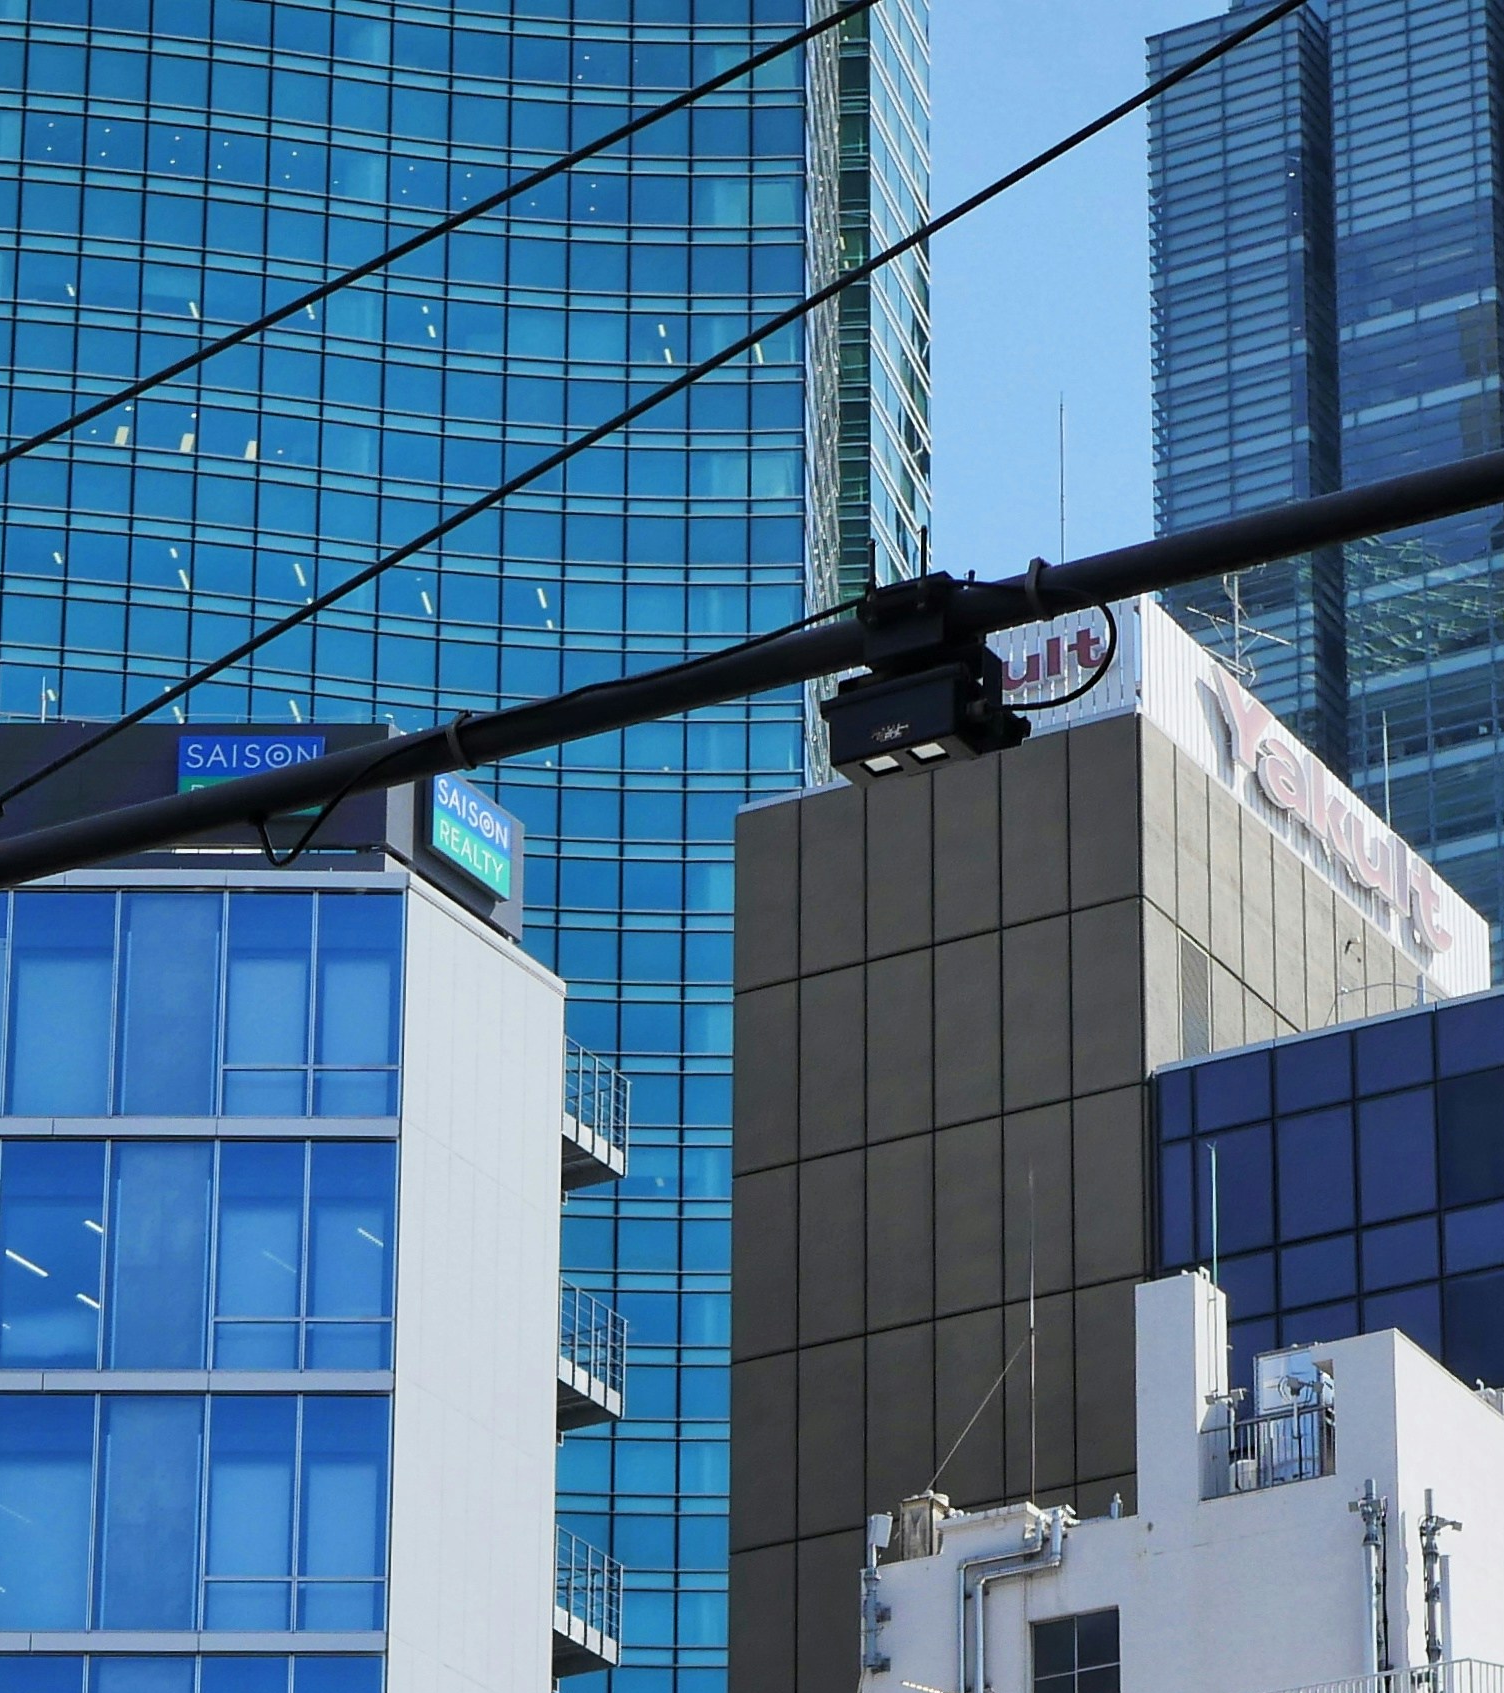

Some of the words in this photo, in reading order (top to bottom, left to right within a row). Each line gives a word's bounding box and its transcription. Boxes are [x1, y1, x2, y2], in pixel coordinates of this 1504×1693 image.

[1002, 628, 1107, 690] ult
[186, 744, 317, 768] SAISON
[438, 779, 508, 848] SAISON
[1211, 664, 1453, 953] Yakult
[440, 820, 503, 882] REALTY
